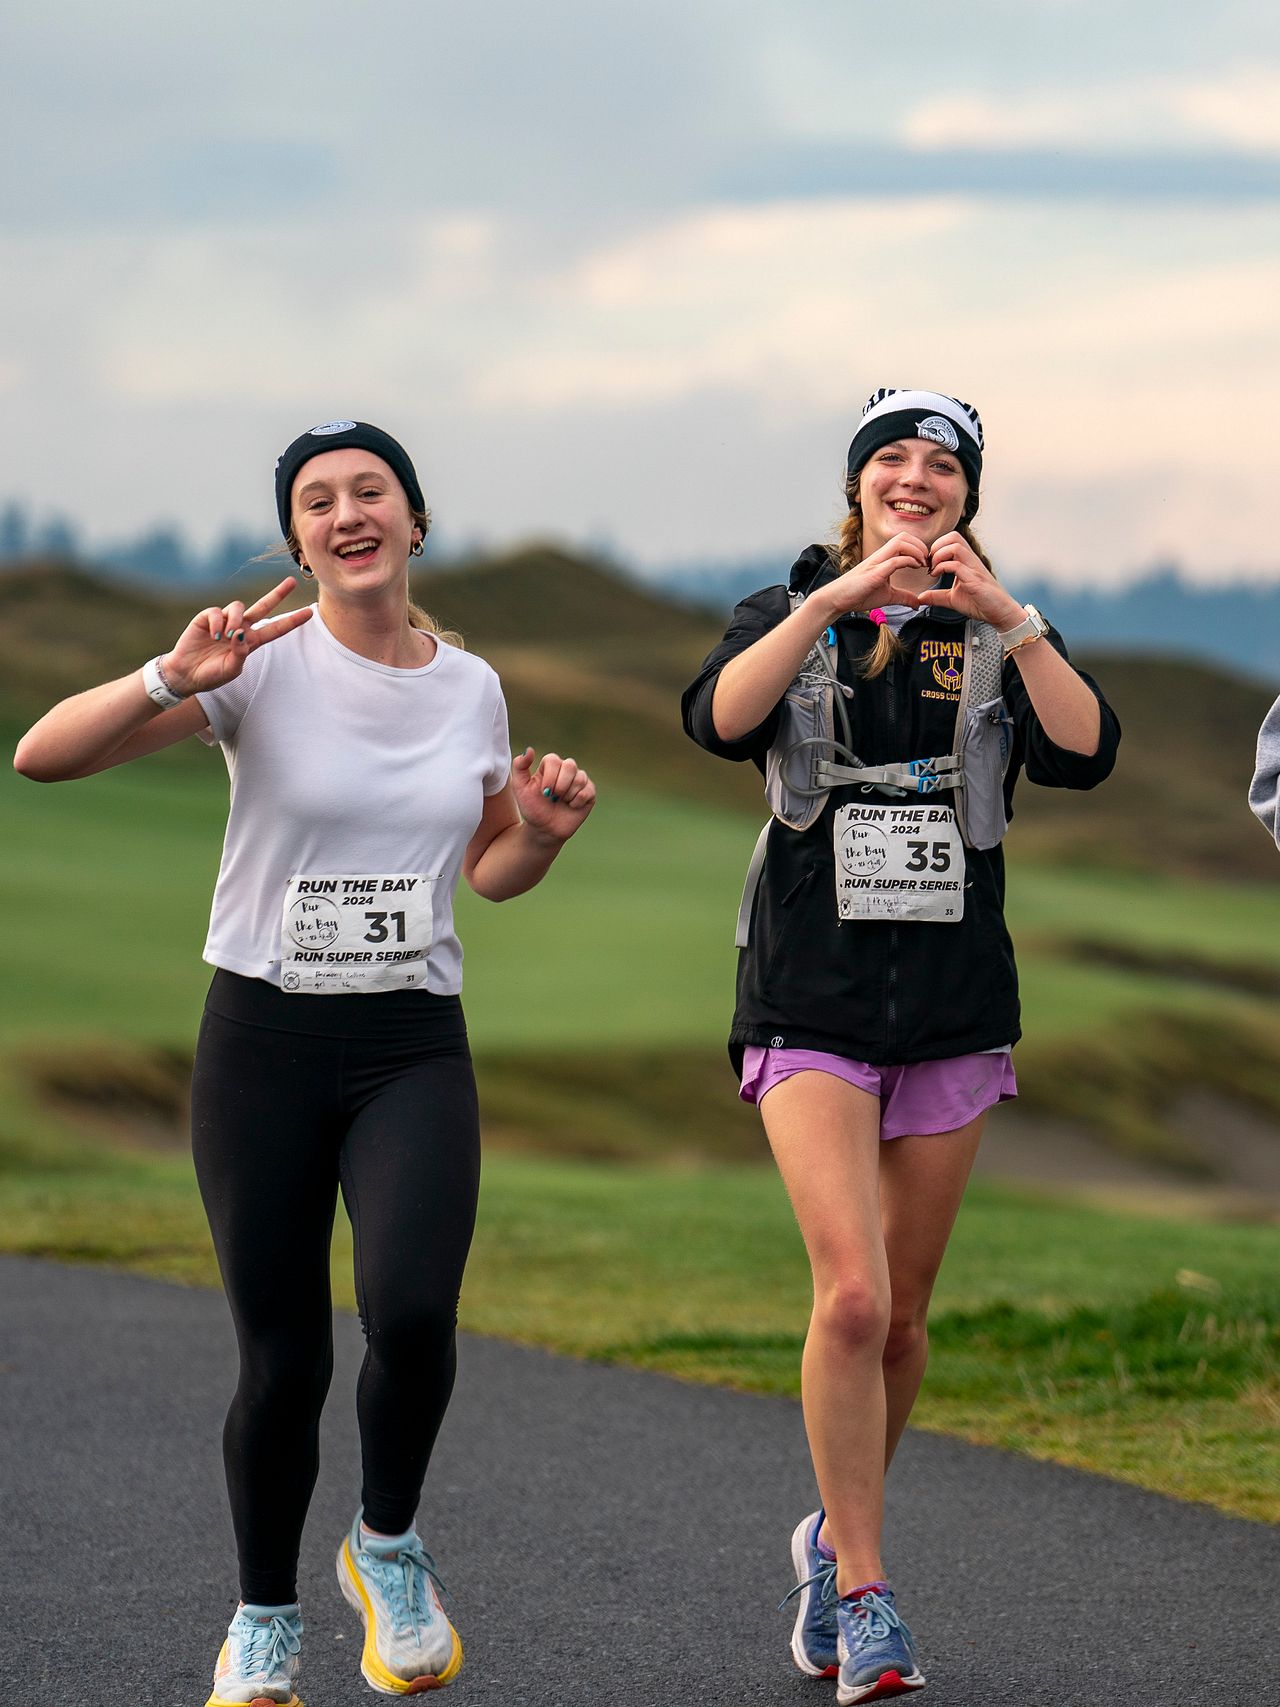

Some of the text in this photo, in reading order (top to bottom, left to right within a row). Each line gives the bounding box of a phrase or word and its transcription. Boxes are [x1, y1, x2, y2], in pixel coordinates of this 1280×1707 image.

[920, 640, 964, 662] SUMN
[922, 690, 960, 701] CROSS COU
[848, 808, 886, 821] RUN
[890, 810, 924, 822] THE
[890, 826, 920, 834] 2024
[905, 841, 950, 872] 35
[298, 879, 418, 893] RUN THE BAY
[844, 879, 958, 890] RUN SUPER SERIES
[342, 897, 374, 905] 2024
[364, 911, 405, 943] 31
[294, 950, 422, 961] RUN SUPER SERIES
